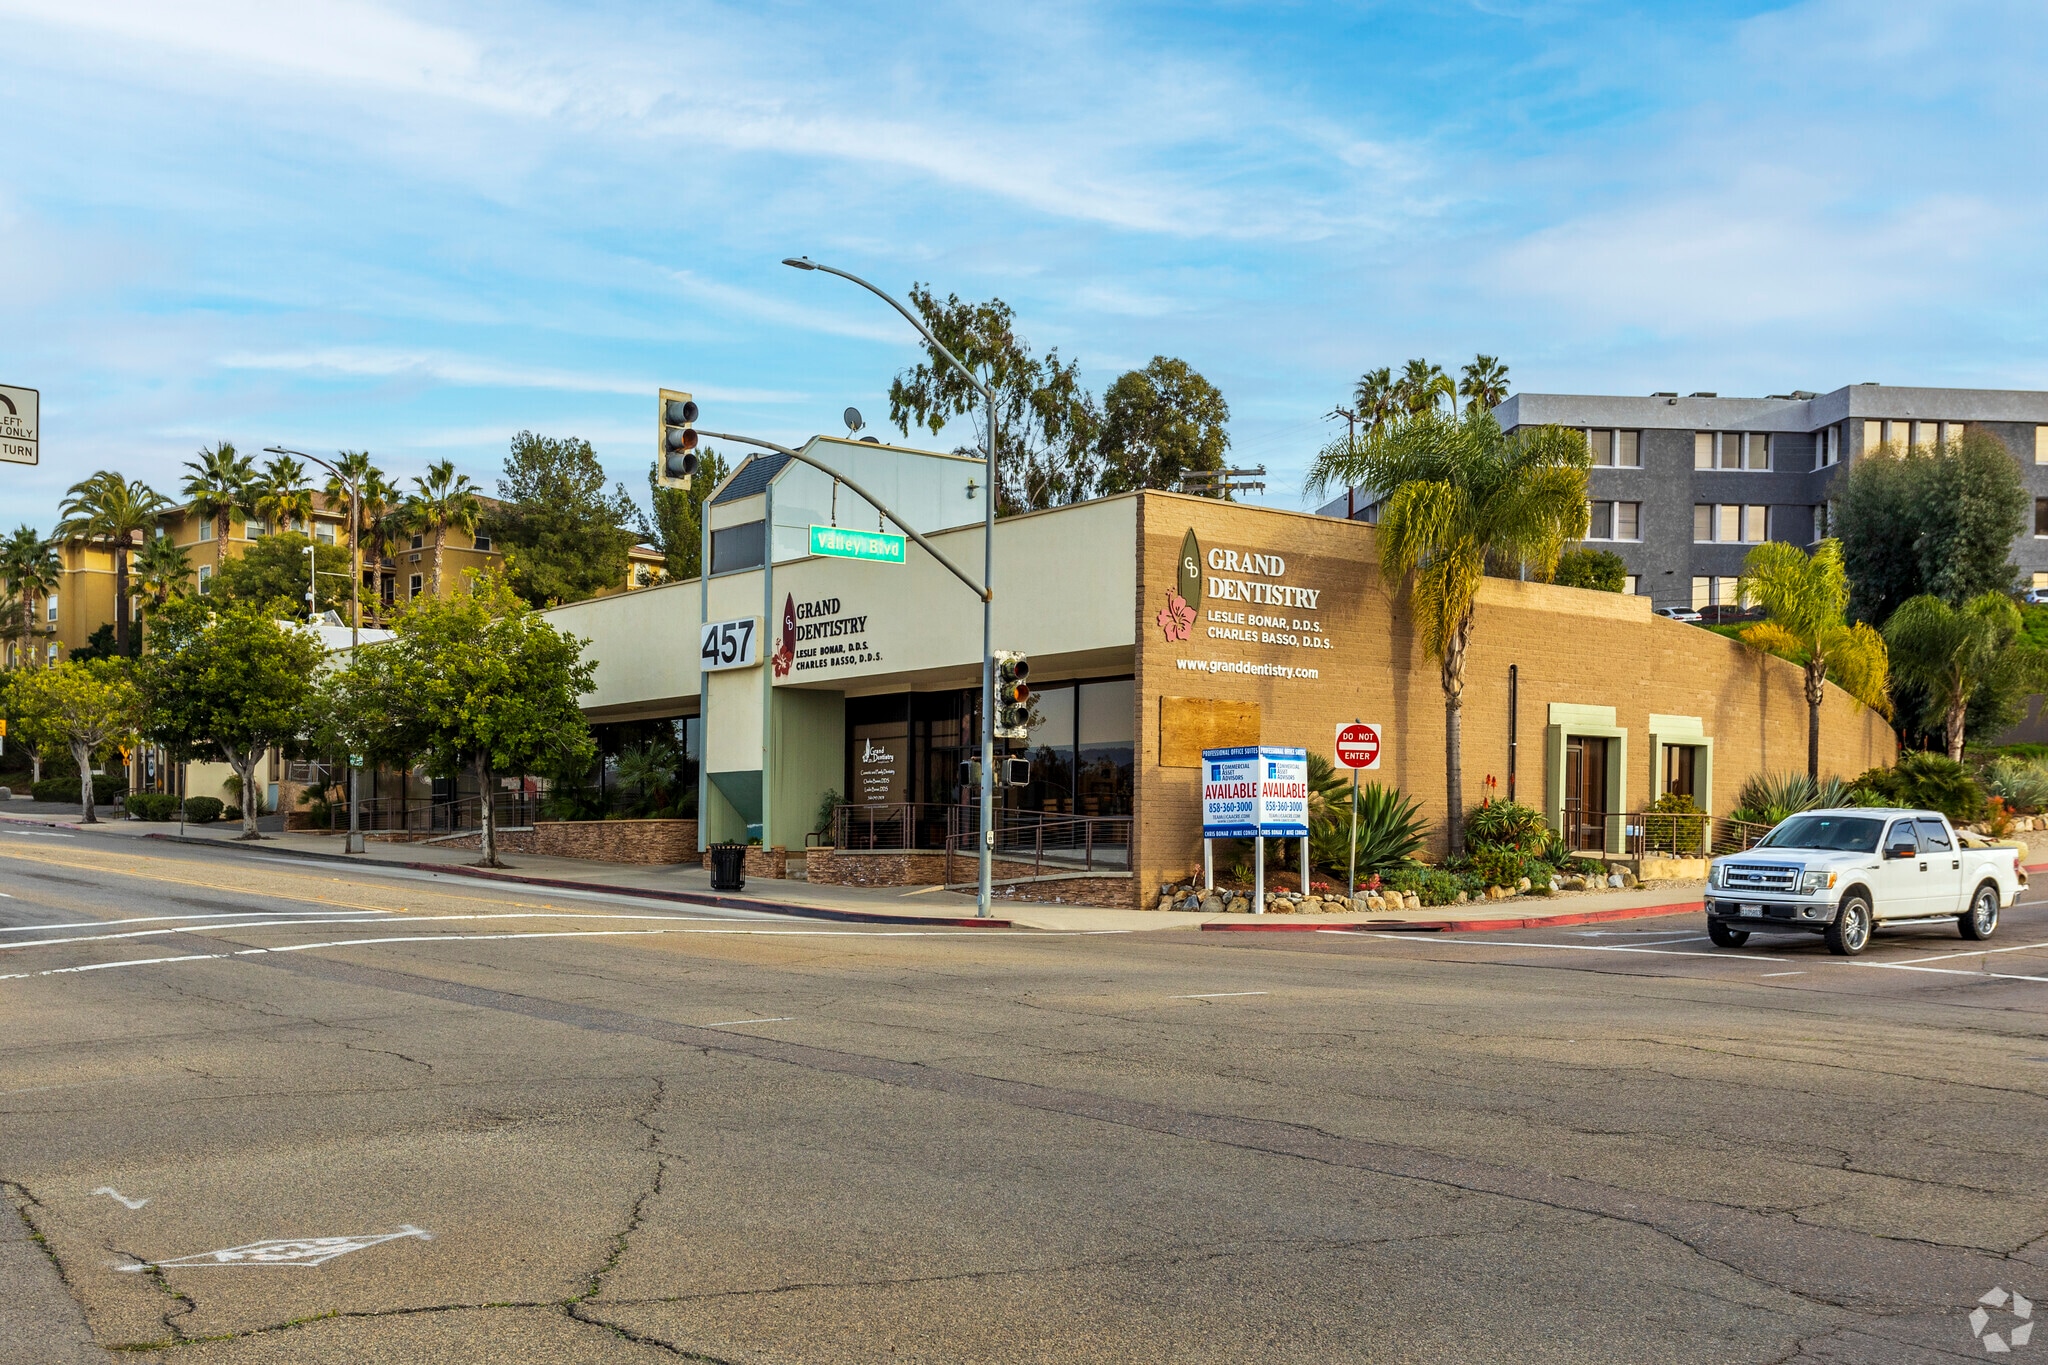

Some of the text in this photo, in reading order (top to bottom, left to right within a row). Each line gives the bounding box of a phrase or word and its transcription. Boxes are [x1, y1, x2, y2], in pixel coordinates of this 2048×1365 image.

[6, 427, 33, 437] ONLY
[3, 443, 33, 456] TURN
[818, 532, 899, 556] Valley Blvd
[1207, 548, 1285, 577] GRAND
[1207, 576, 1320, 609] DENTISTRY
[796, 598, 841, 619] GRAND
[796, 615, 868, 641] DENTISTRY
[1208, 609, 1323, 633] LESLIE BONAR, D.D.S.
[702, 619, 754, 666] 457
[1207, 626, 1334, 650] CHARLES BASSO, D.D.S.
[796, 641, 869, 658] LESLIE BONAR, D.D.S.
[796, 652, 883, 671] CHARLES BASSO, D.D.S.
[1177, 659, 1319, 680] www.granddentistry.com
[1343, 732, 1374, 742] DO NOT
[1344, 752, 1370, 761] ENTER
[1205, 782, 1257, 800] AVAILABLE
[1262, 782, 1306, 799] AVAILABLE
